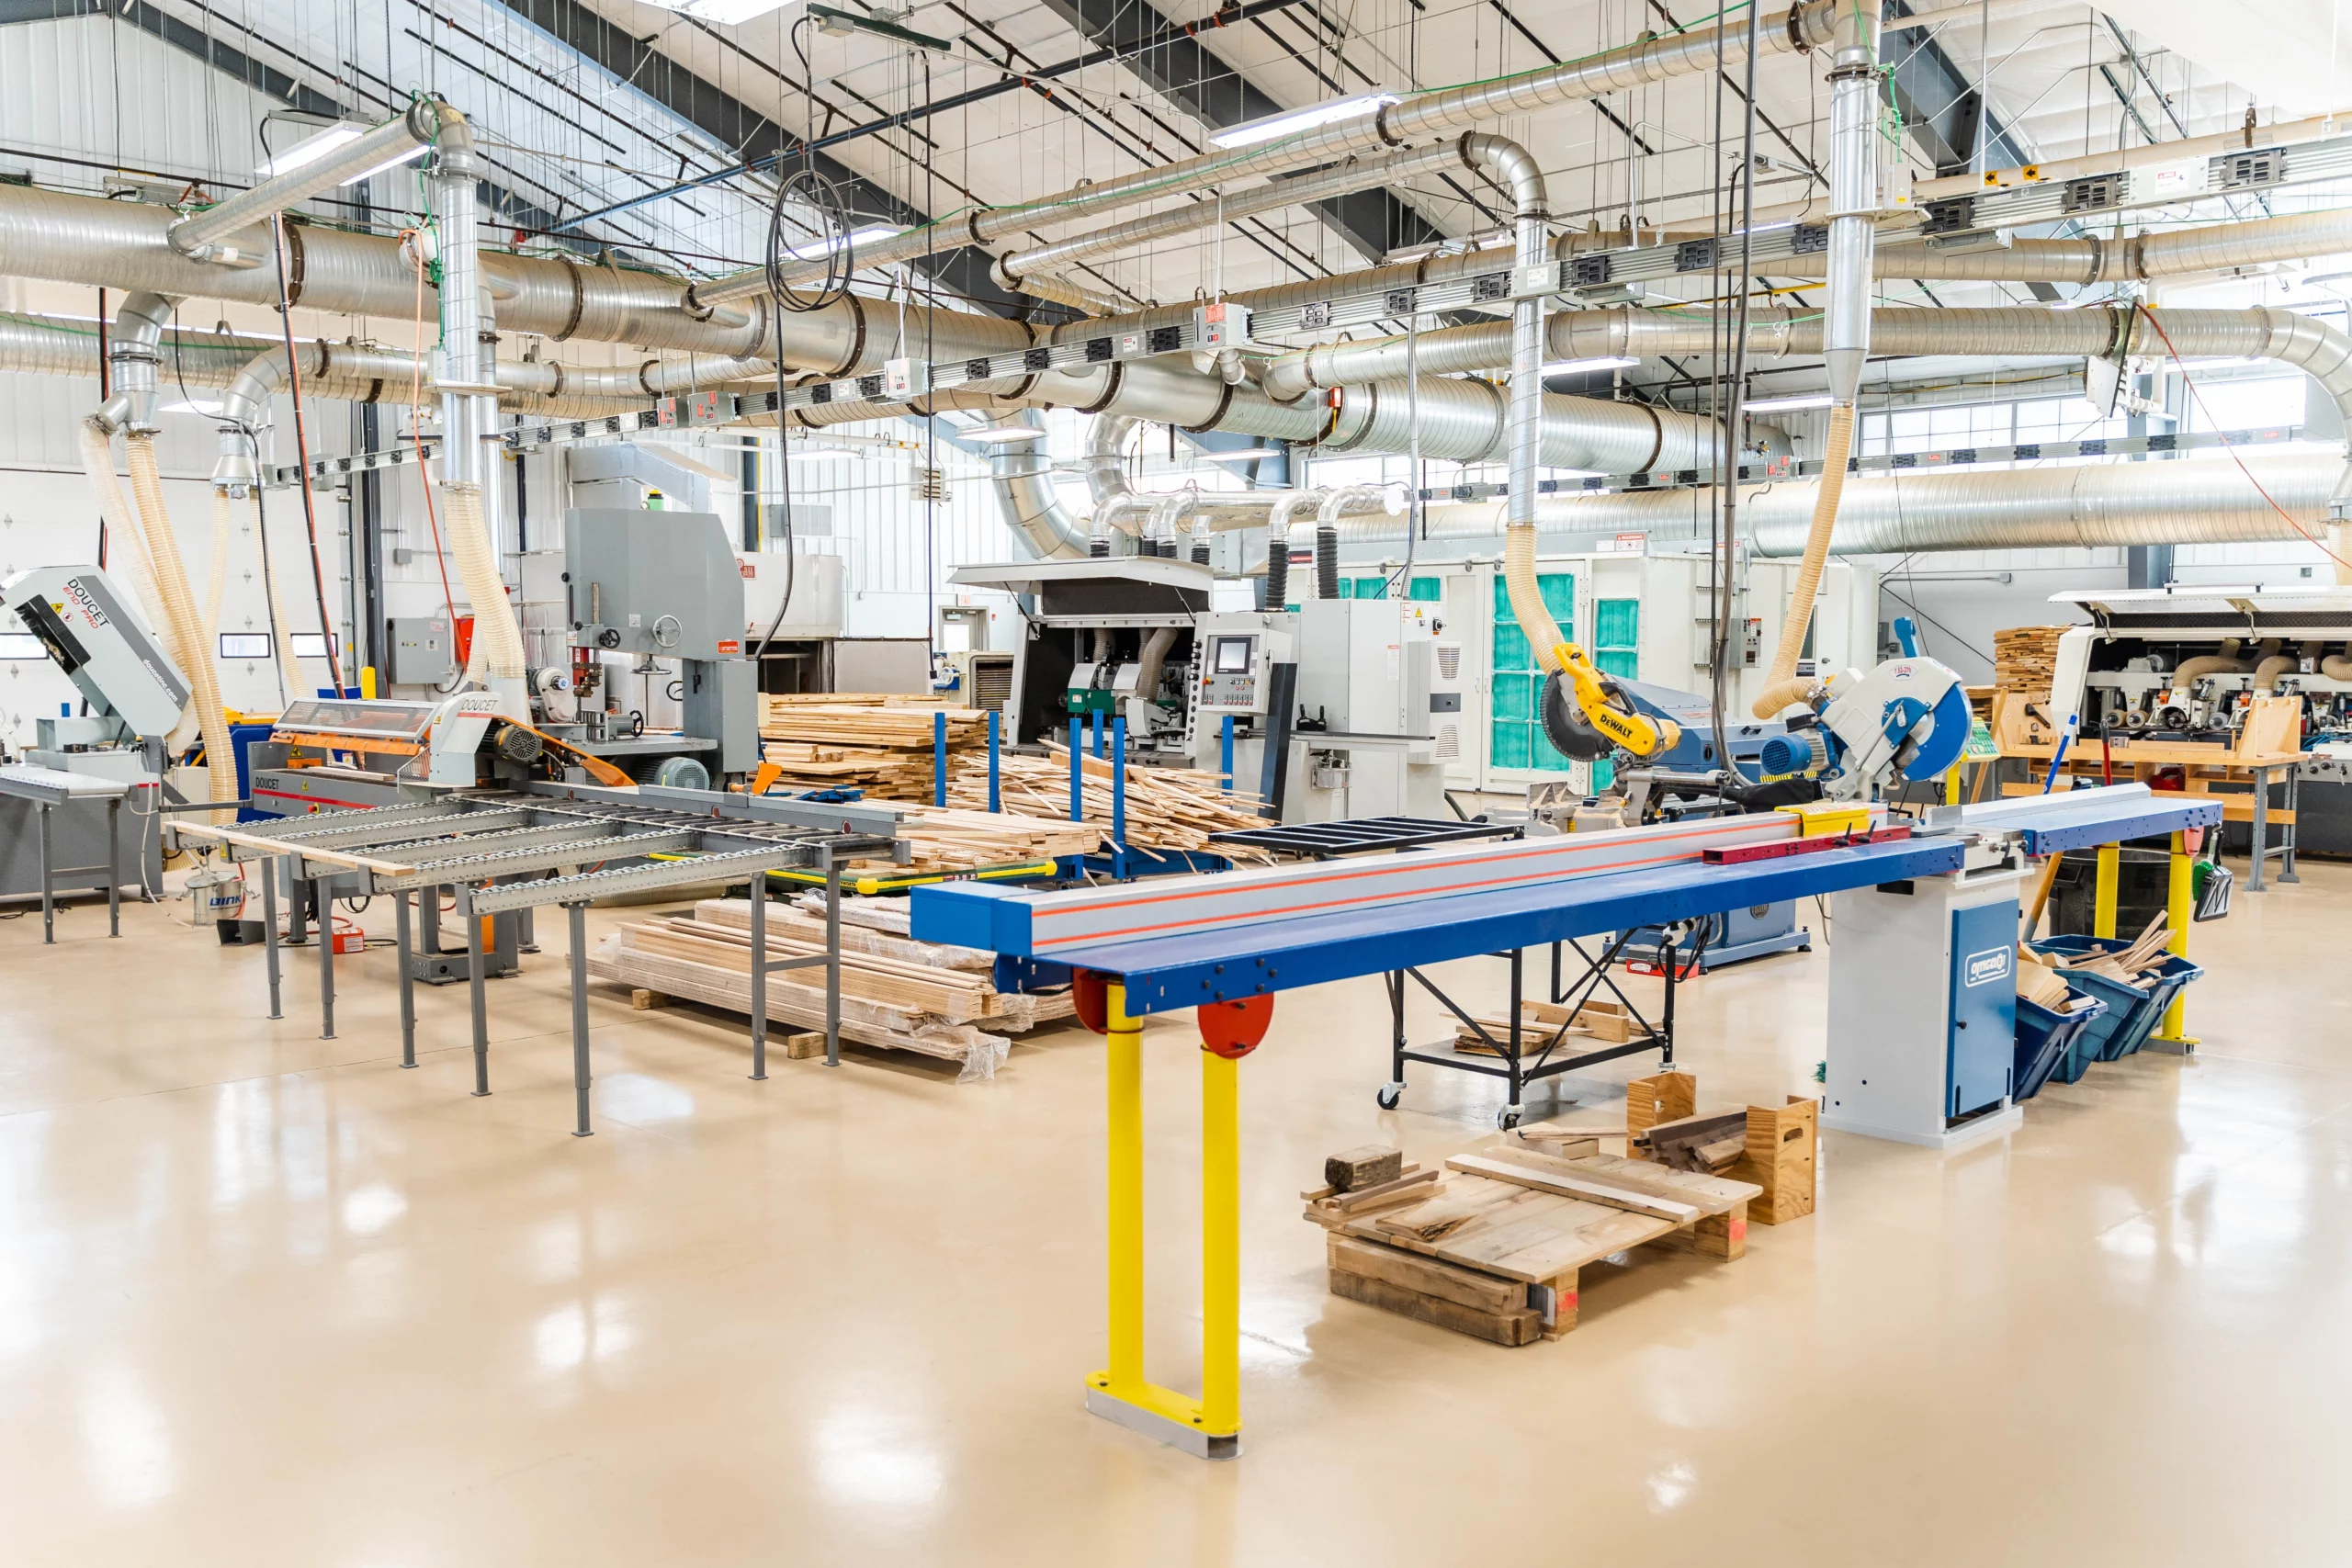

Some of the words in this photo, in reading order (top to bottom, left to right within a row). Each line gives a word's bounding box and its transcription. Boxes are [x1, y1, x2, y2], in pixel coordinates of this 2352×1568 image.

[62, 586, 80, 605] END
[81, 609, 99, 629] PRO
[67, 579, 110, 626] DOUCET
[142, 659, 178, 702] doucetinc.com
[460, 699, 499, 711] DOUCET
[255, 776, 279, 790] DOUCET
